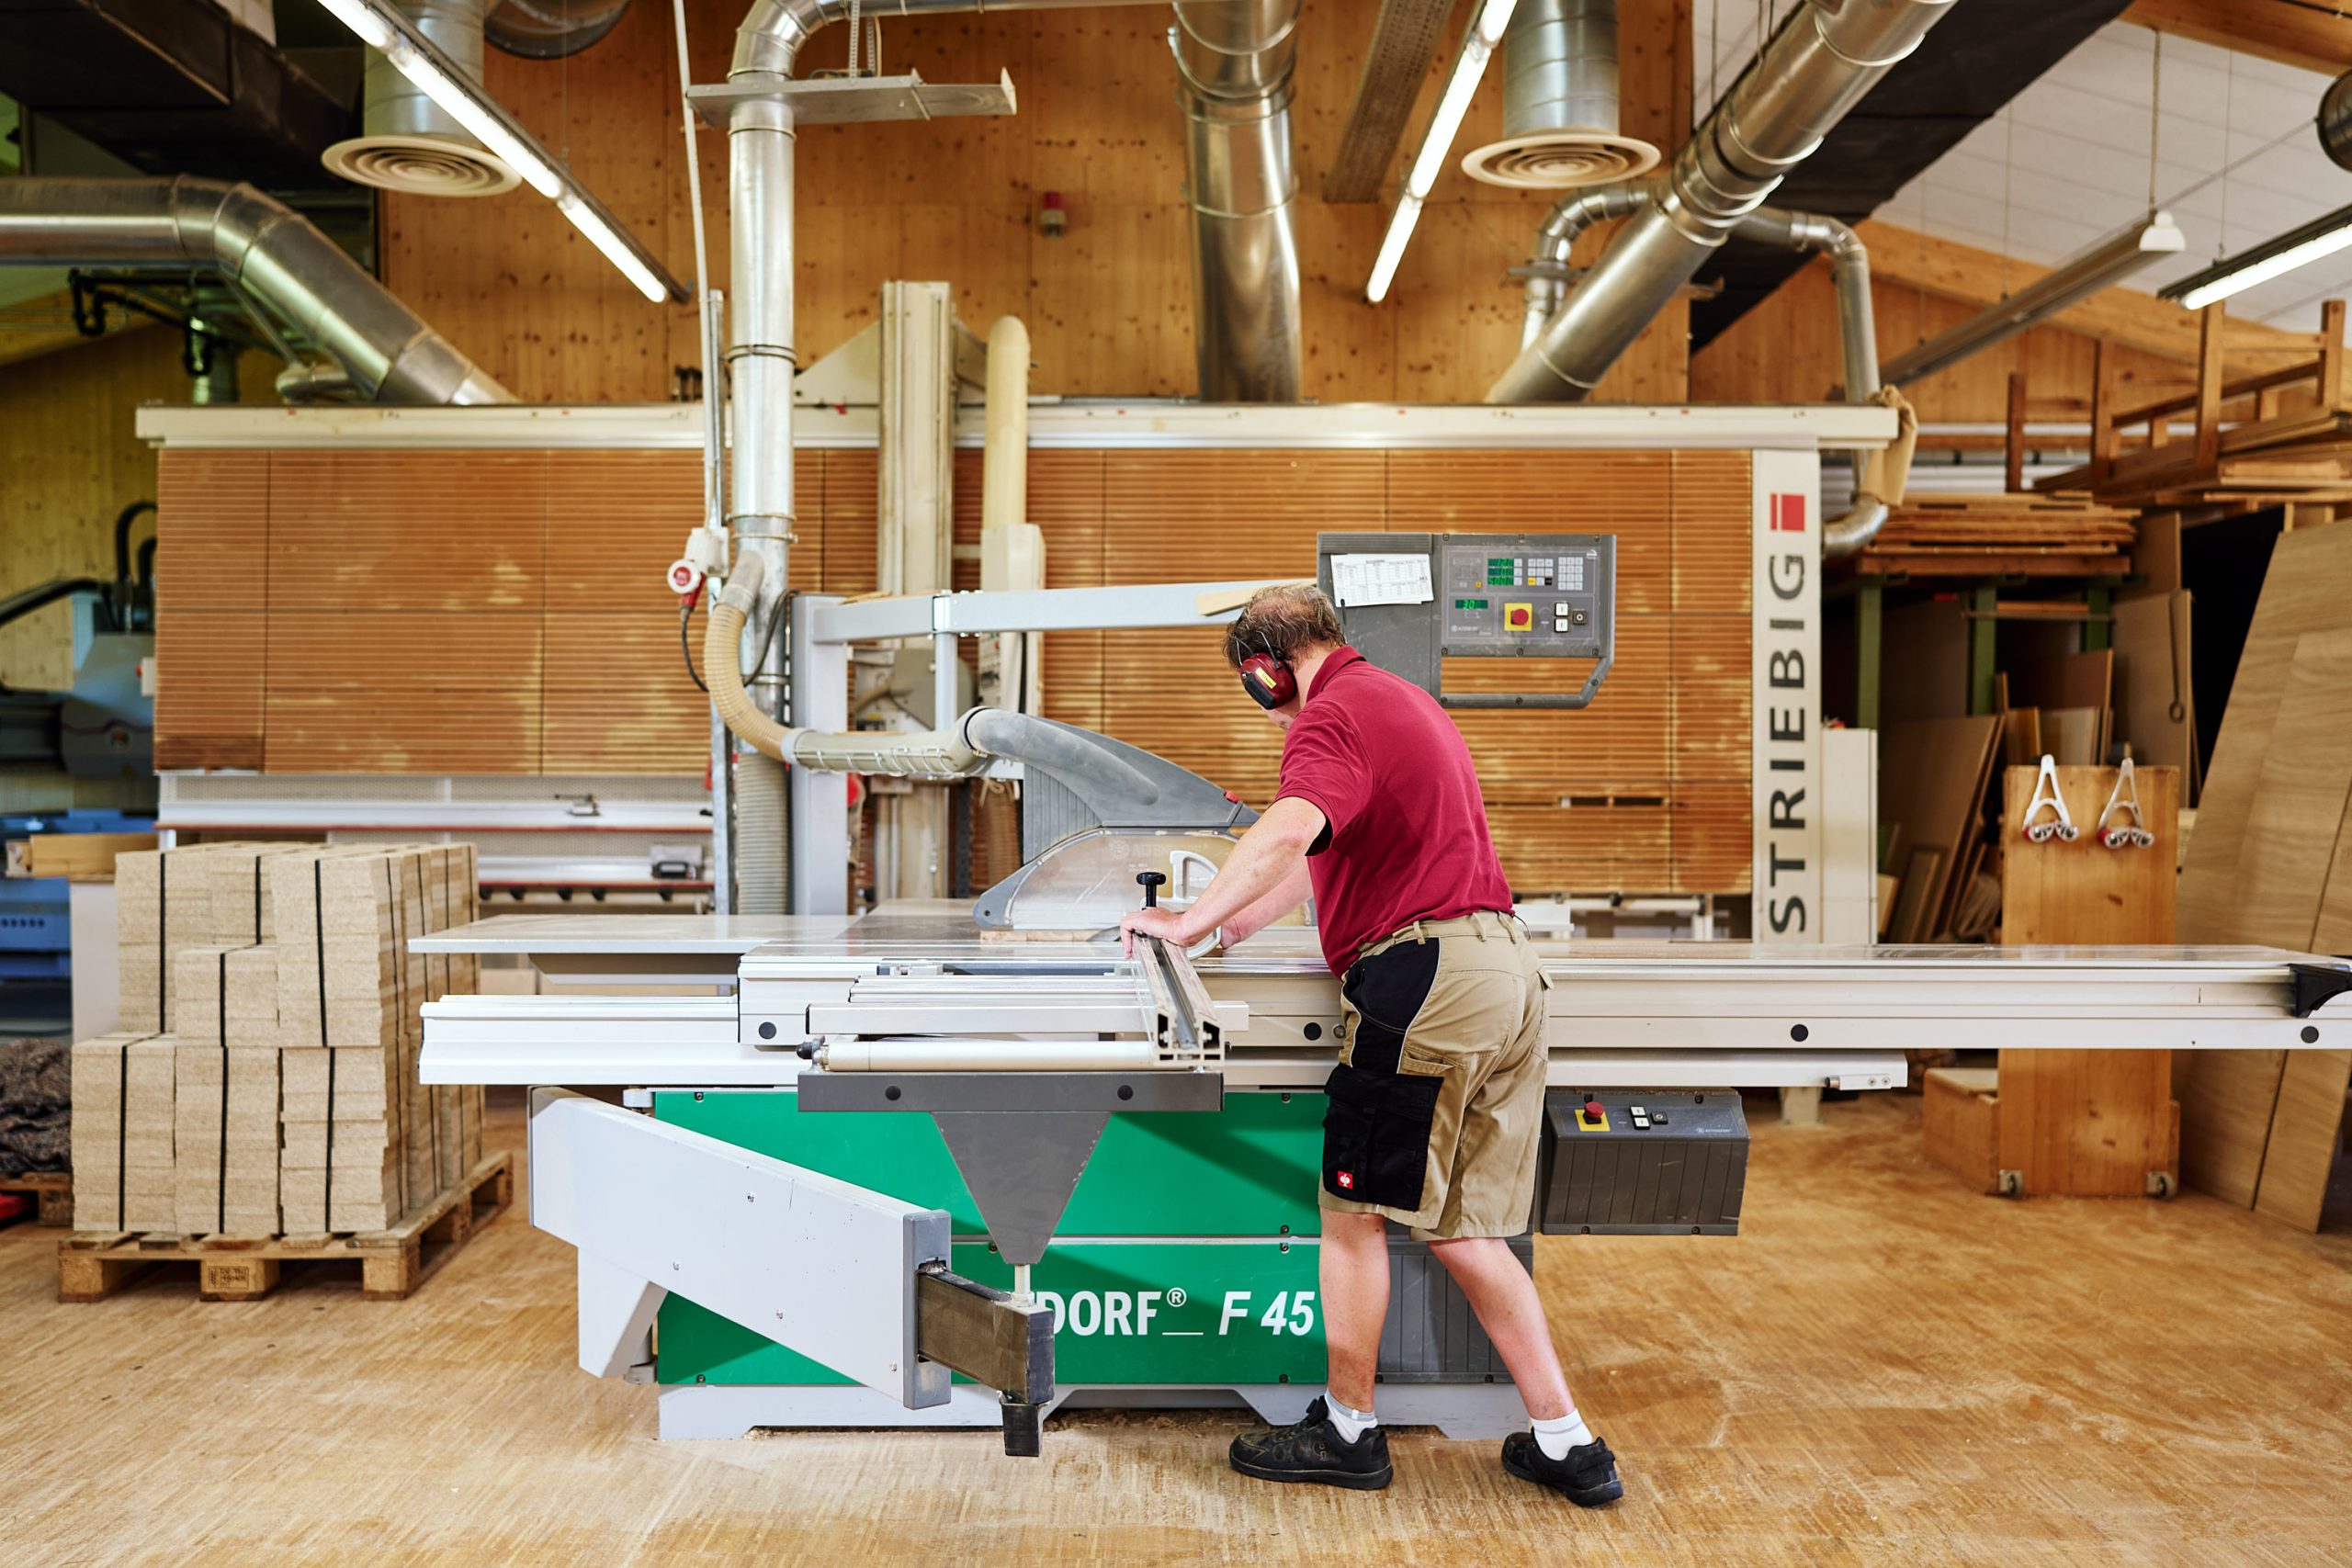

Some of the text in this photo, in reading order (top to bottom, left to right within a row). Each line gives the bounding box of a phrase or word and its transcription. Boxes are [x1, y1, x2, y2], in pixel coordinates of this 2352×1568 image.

[1770, 553, 1806, 933] STRIEBIG
[1218, 1291, 1252, 1336] F
[1260, 1291, 1316, 1337] 45
